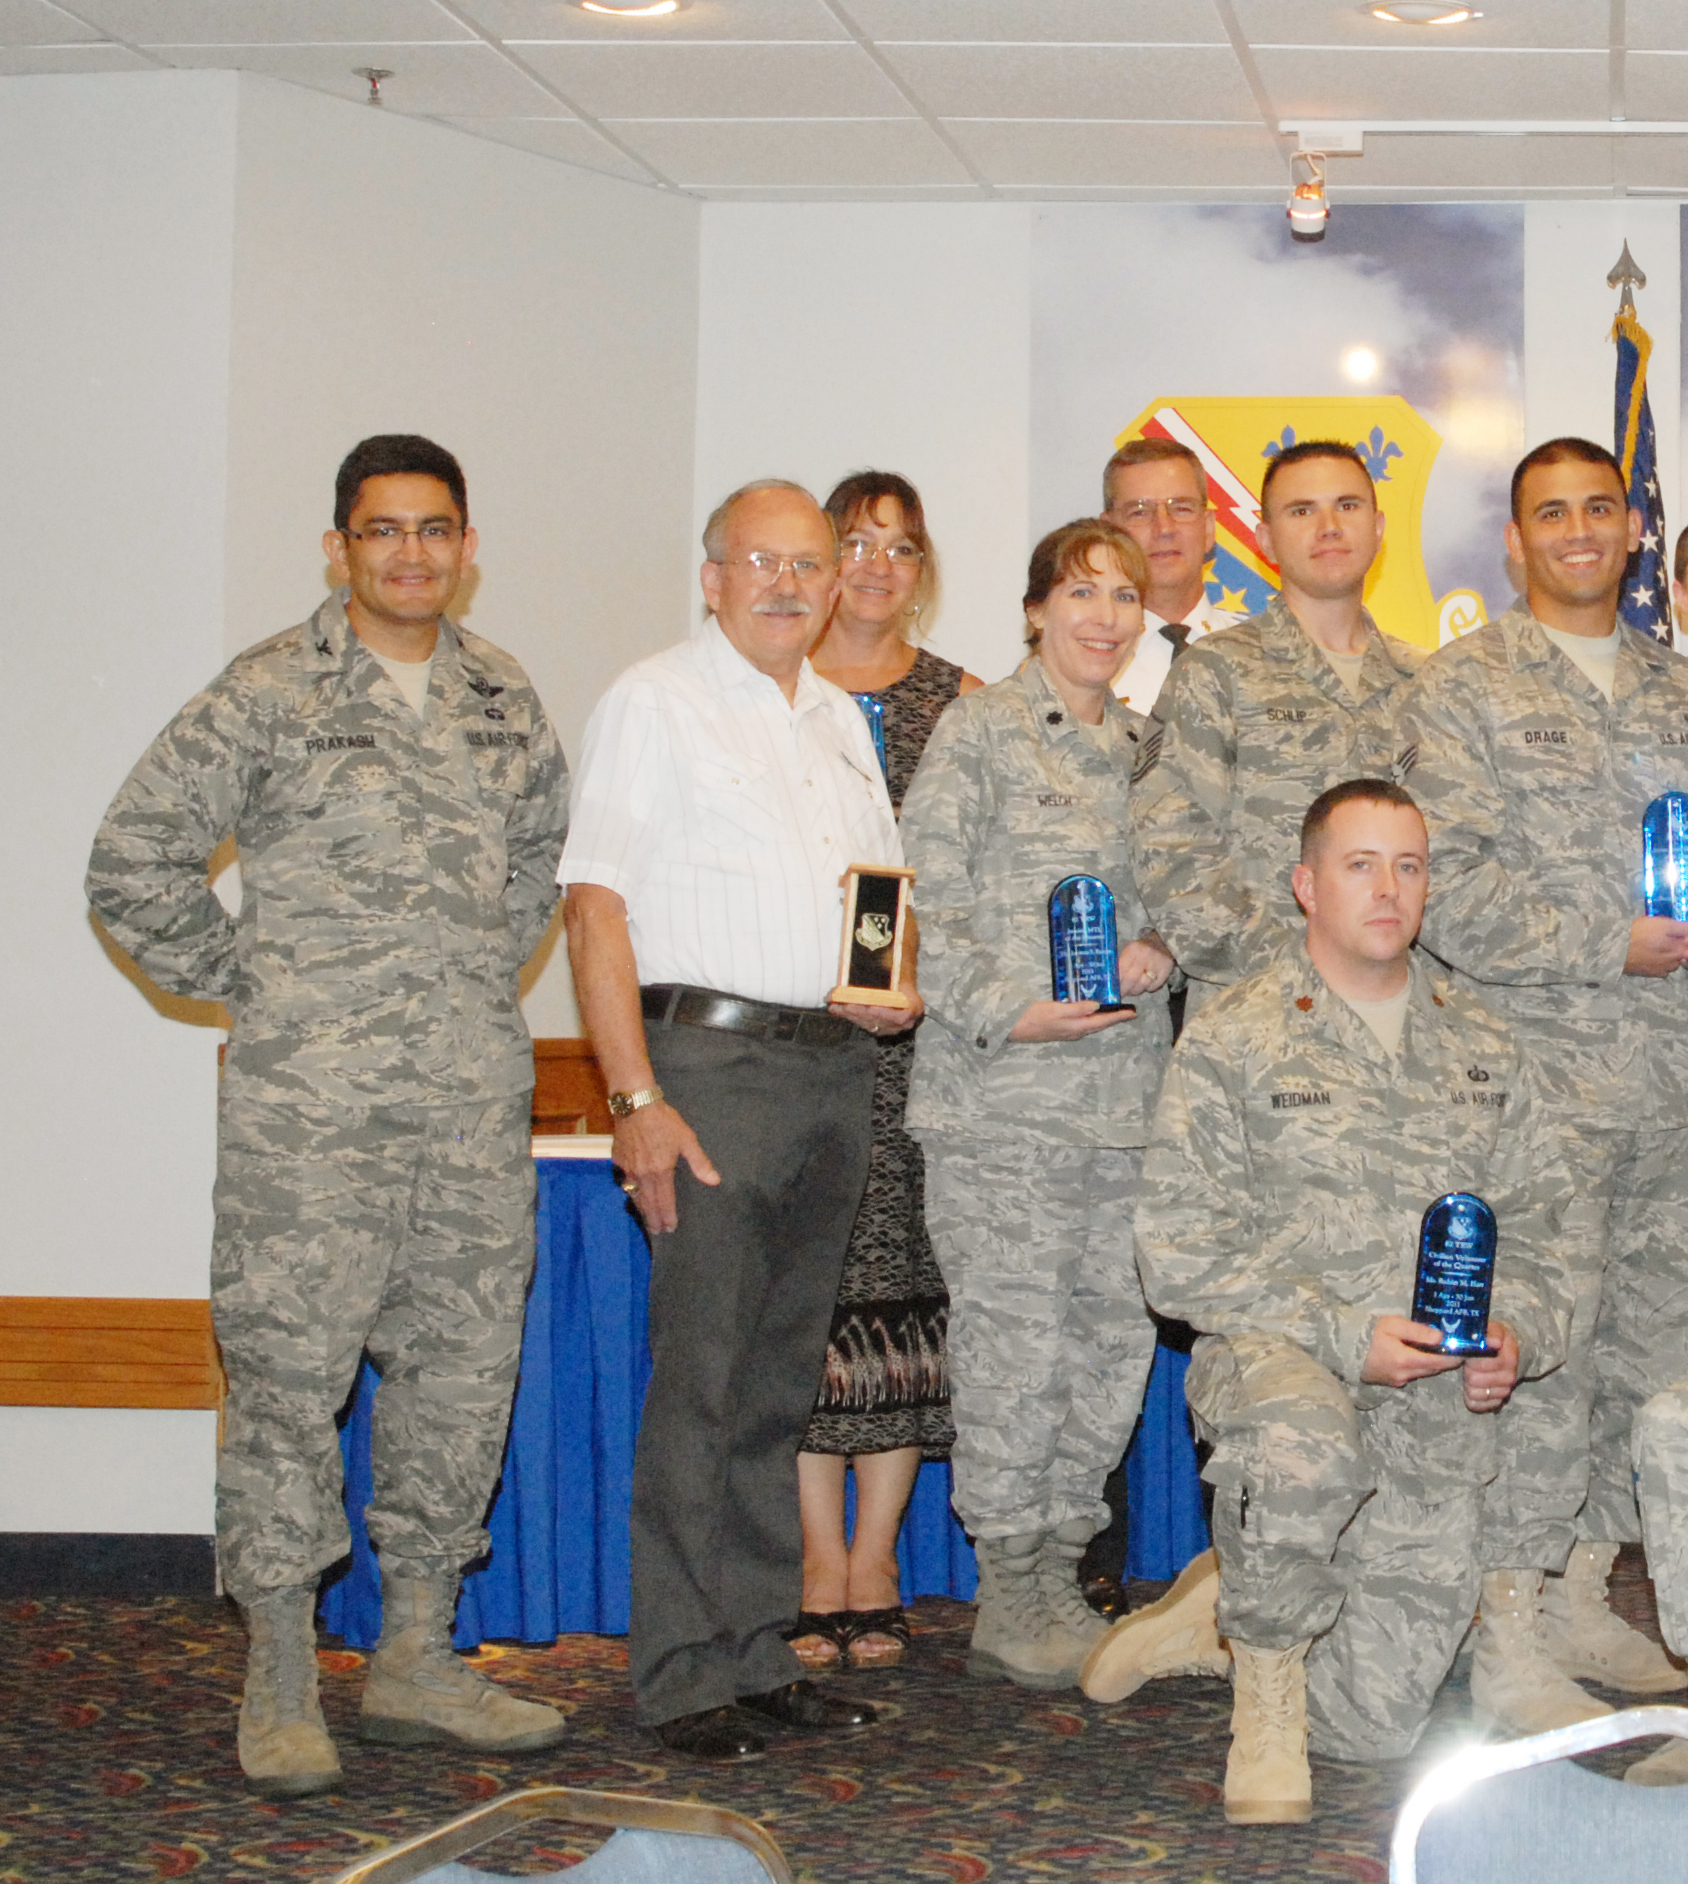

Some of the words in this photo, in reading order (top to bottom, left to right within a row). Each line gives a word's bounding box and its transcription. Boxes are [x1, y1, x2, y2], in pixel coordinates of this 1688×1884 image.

[305, 734, 377, 755] PRAKASH
[1525, 730, 1567, 744] DRAGE
[1270, 1091, 1332, 1109] WEIDMAN
[1472, 1091, 1489, 1107] AIR
